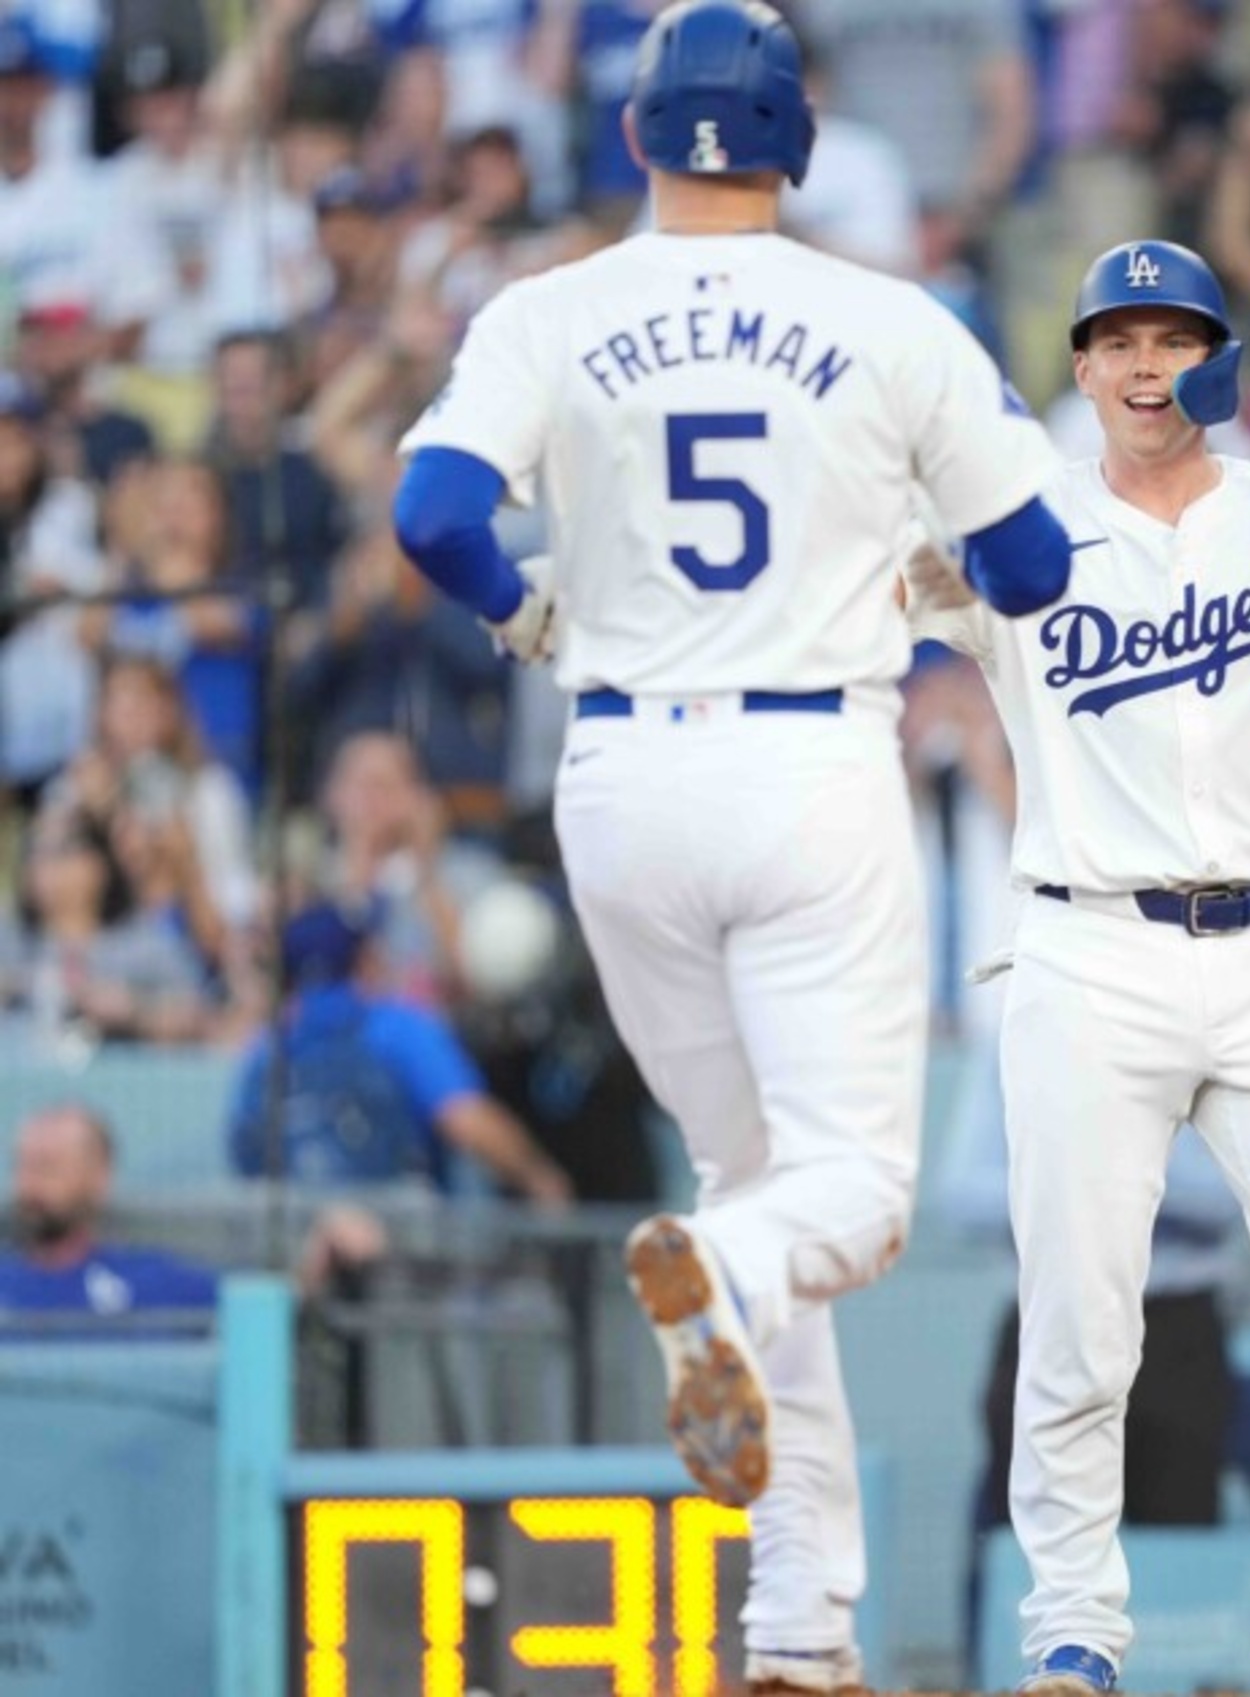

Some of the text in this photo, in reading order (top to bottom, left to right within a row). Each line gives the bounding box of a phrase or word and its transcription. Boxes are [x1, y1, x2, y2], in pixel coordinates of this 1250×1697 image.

[694, 119, 718, 151] 5
[1124, 245, 1161, 288] LA
[581, 309, 853, 402] FREEMAN
[664, 411, 770, 593] 5
